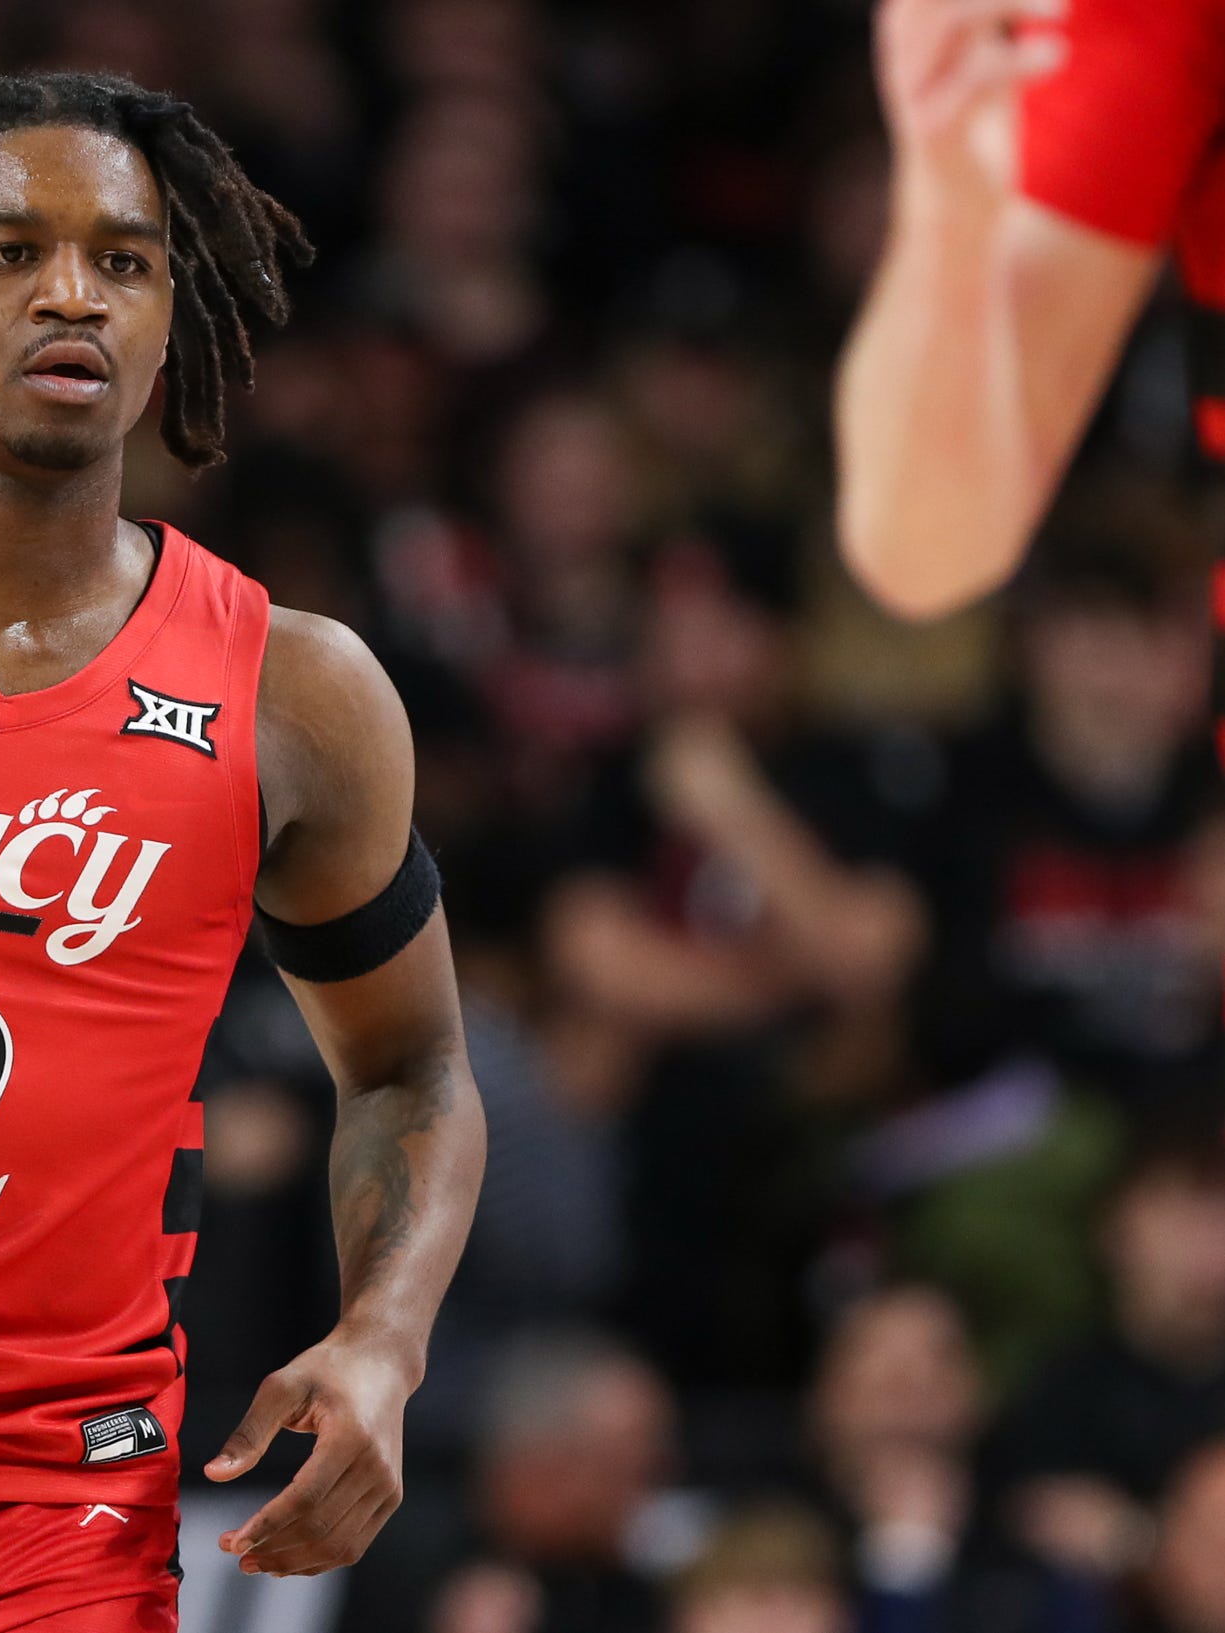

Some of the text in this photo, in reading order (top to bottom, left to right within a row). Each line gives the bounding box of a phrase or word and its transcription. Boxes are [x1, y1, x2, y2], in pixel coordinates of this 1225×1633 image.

[126, 685, 217, 752] XII
[87, 1415, 128, 1436] ENGINEERED
[139, 1418, 156, 1439] M
